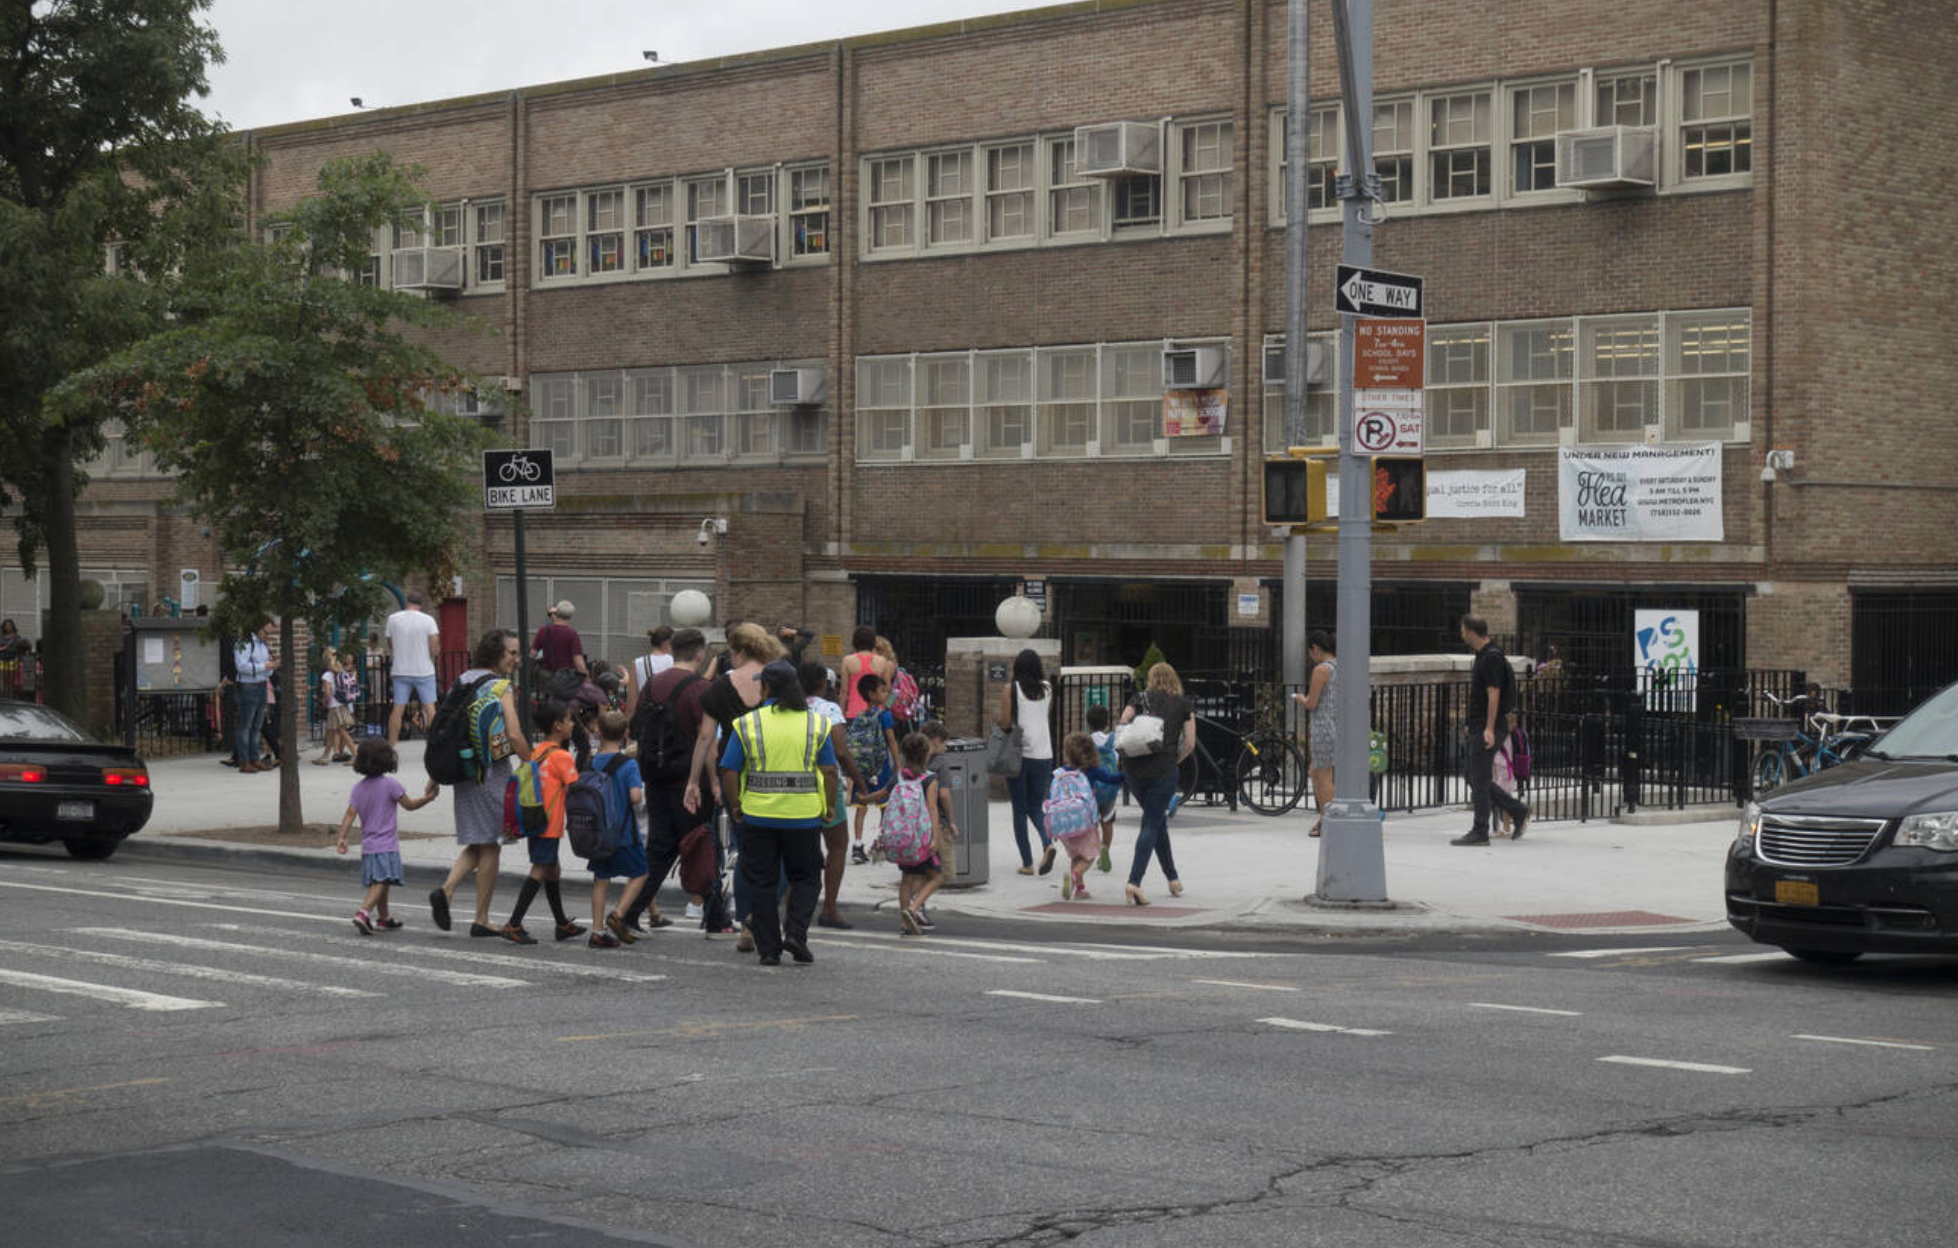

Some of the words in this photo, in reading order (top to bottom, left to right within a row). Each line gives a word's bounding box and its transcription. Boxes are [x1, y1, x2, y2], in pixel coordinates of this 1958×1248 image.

[1349, 281, 1374, 302] ONE
[1385, 286, 1412, 307] WAY
[1359, 325, 1373, 336] NO
[1377, 325, 1420, 337] STANDING
[1361, 349, 1392, 357] SCHOOL
[1400, 423, 1423, 435] SAT
[1563, 451, 1600, 459] UNDER
[1603, 451, 1630, 459] NEW
[1632, 447, 1716, 459] MANAGEMENT!
[489, 489, 517, 504] BIKE
[521, 487, 551, 502] LANE
[1446, 483, 1480, 497] justice
[1577, 471, 1628, 507] Flea
[1578, 509, 1627, 527] MARKET
